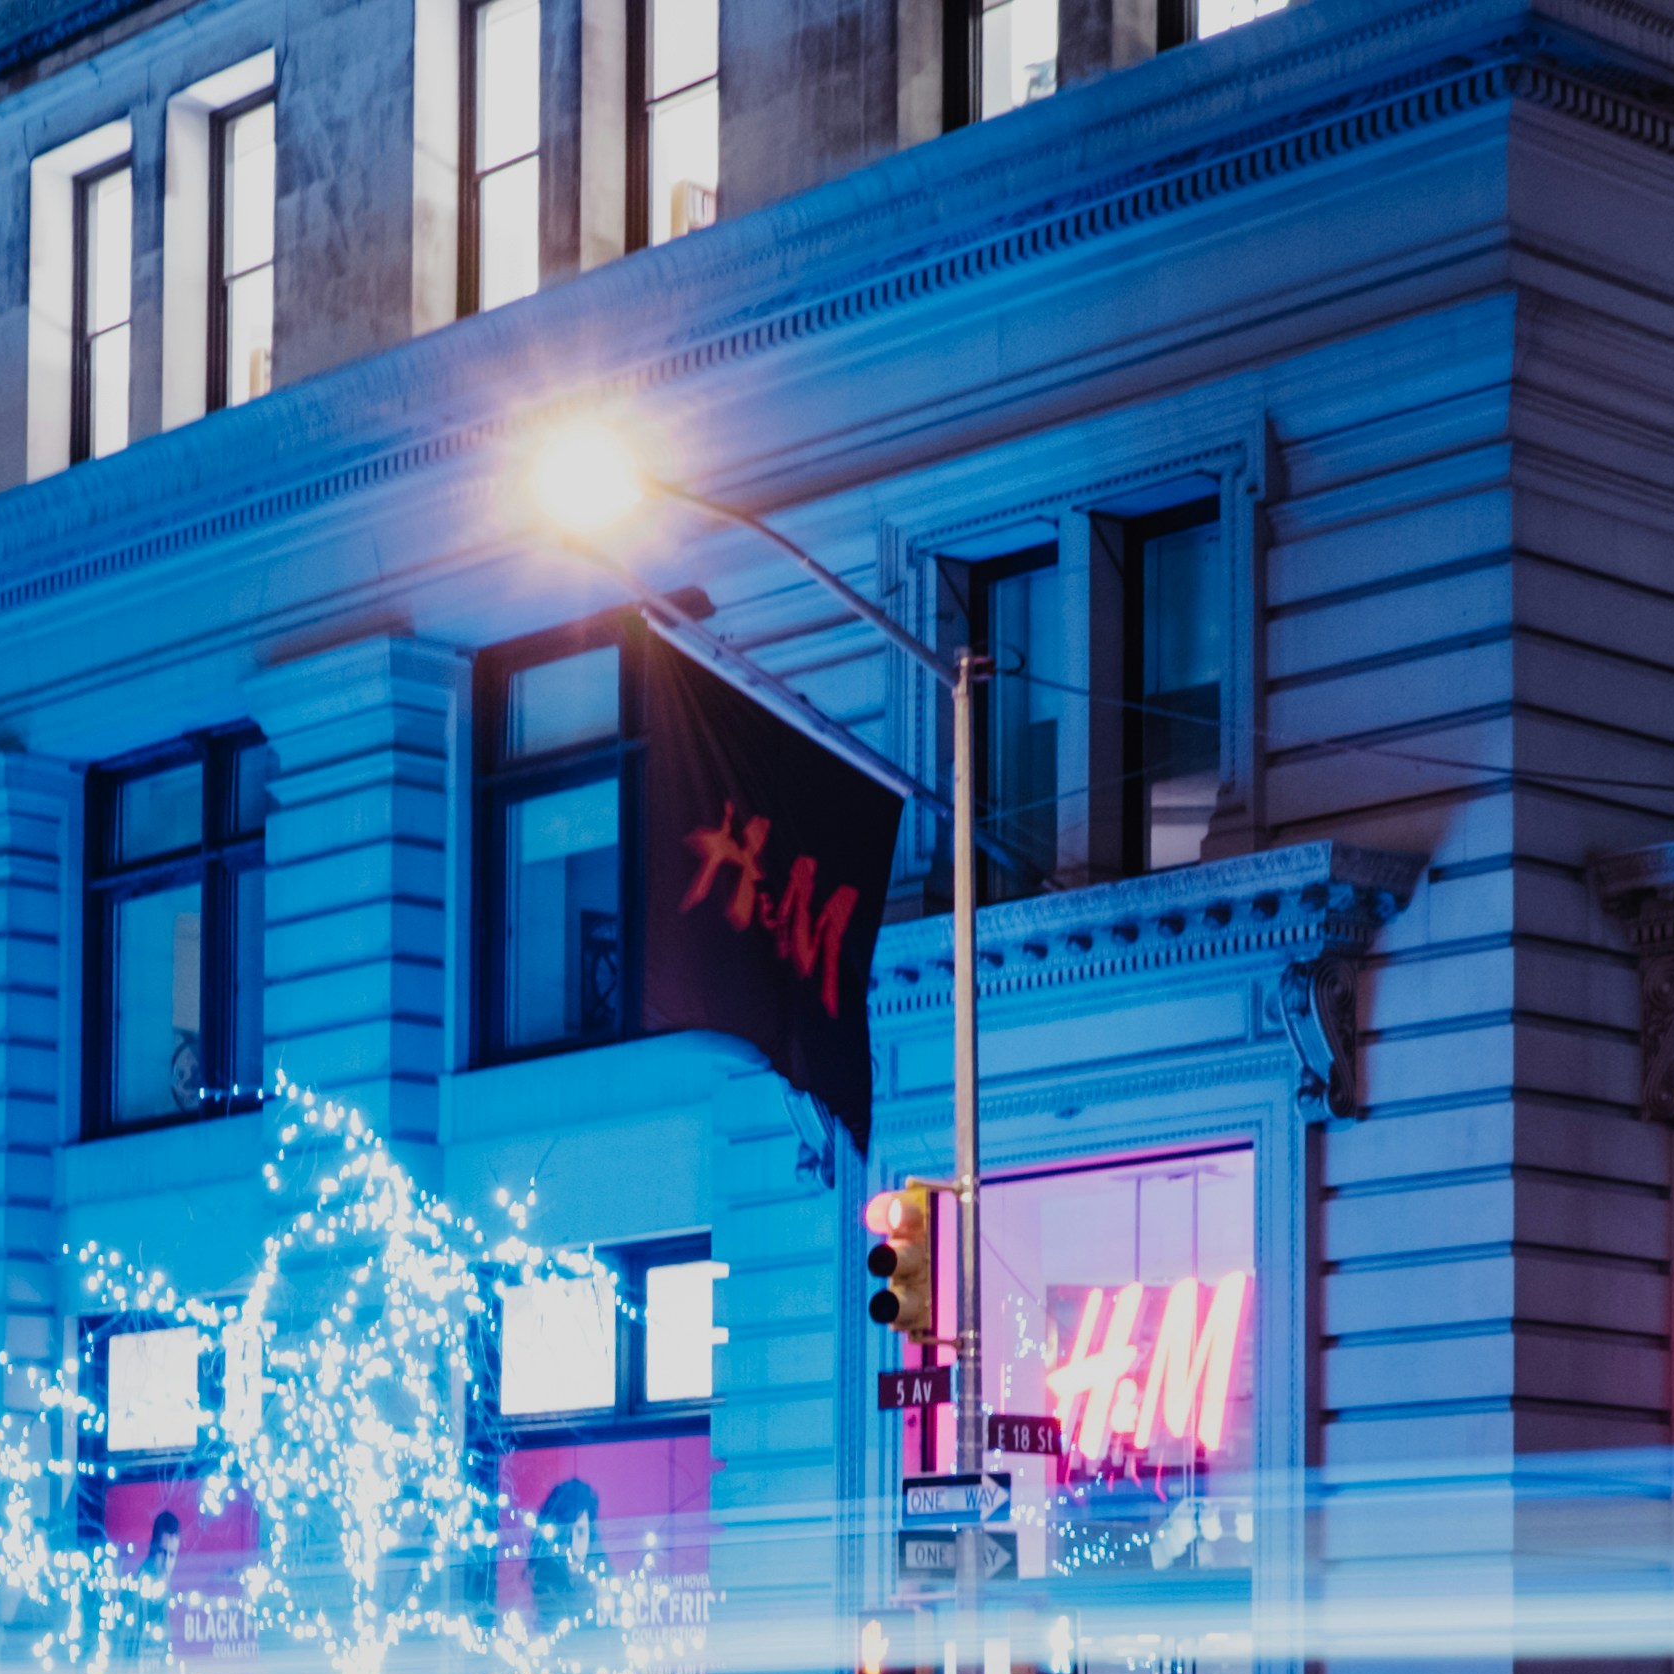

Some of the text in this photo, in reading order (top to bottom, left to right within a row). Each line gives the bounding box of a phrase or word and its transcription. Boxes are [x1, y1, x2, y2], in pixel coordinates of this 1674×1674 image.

[681, 801, 858, 1018] H&M
[1045, 1270, 1251, 1460] H&M
[896, 1377, 932, 1406] 5 Av
[998, 1423, 1053, 1452] E 18 St
[911, 1486, 998, 1512] ONE WAY
[915, 1545, 943, 1564] ONE
[184, 1611, 239, 1642] BLACK
